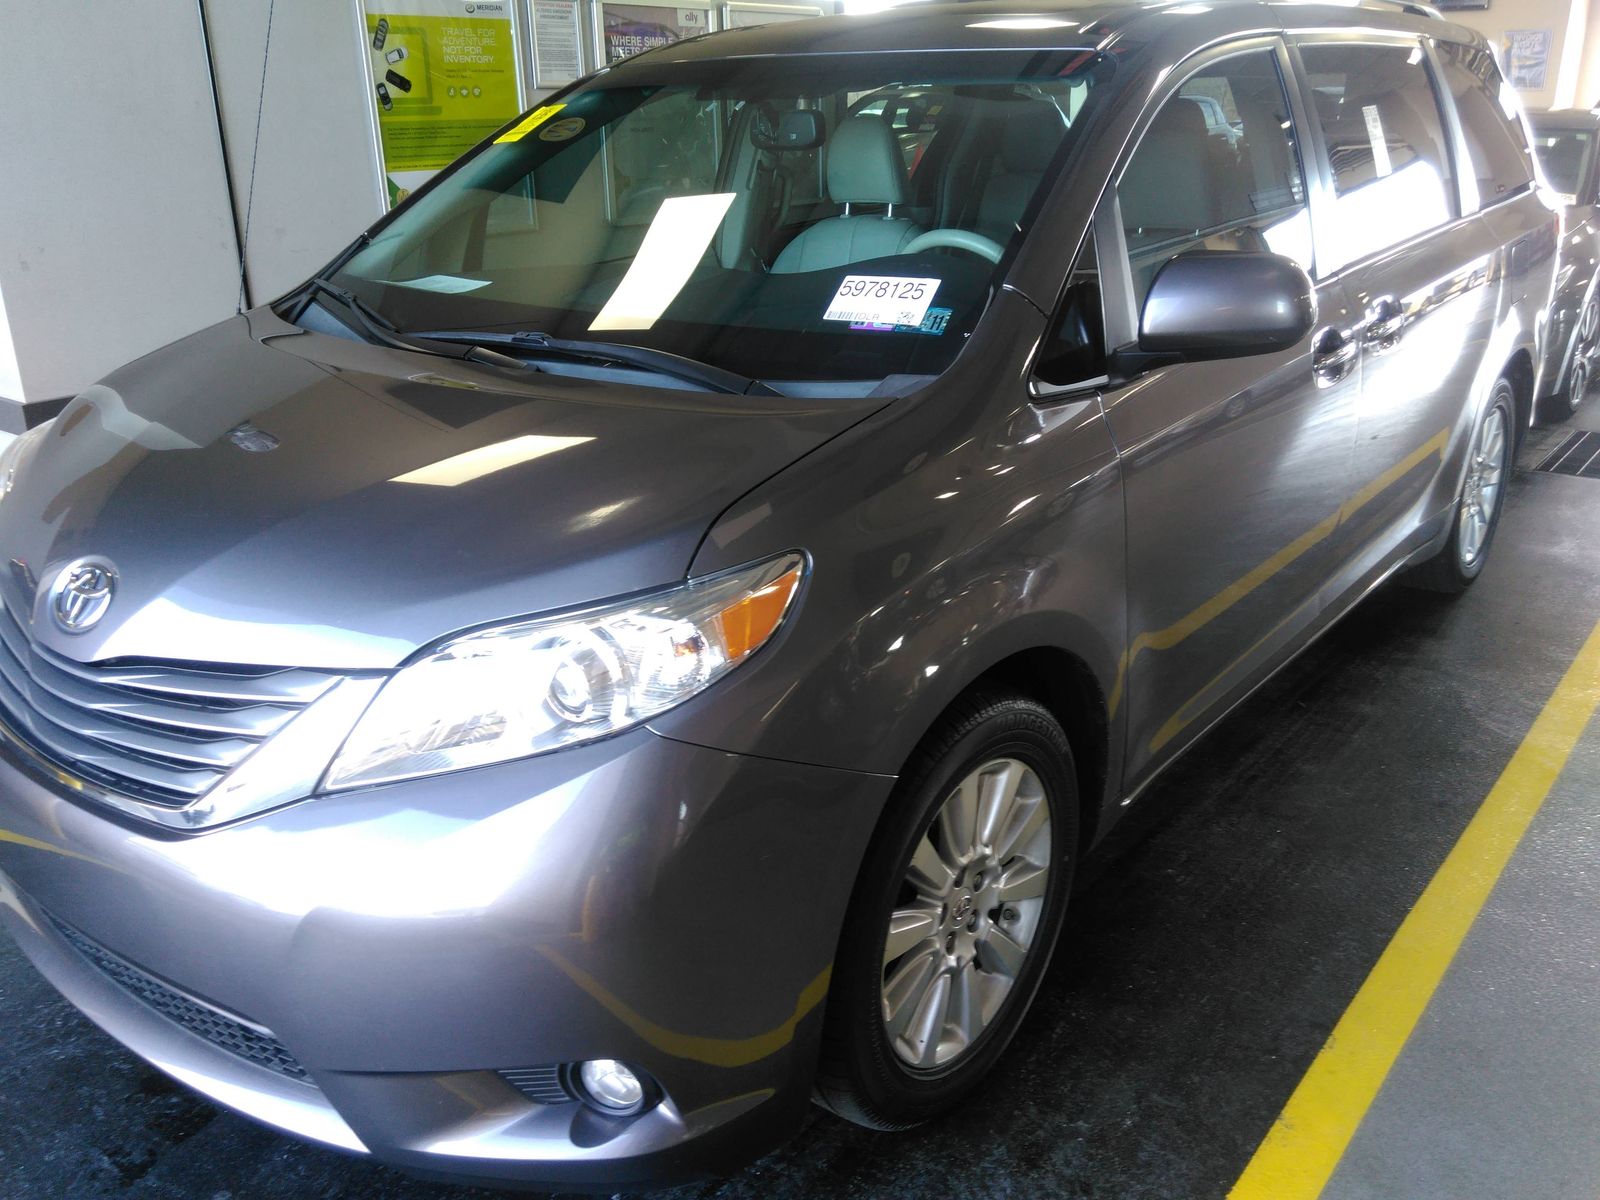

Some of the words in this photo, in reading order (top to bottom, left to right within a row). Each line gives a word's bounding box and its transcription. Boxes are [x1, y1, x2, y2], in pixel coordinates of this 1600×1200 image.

[476, 4, 503, 12] MERIDIAN
[685, 12, 698, 24] ally
[441, 27, 476, 37] TRAVEL
[477, 28, 496, 37] FOR
[442, 37, 497, 46] ADVENTURE
[610, 35, 642, 46] WHERE
[443, 46, 461, 55] NOT
[464, 46, 483, 55] FOR
[839, 280, 927, 300] 5978125
[929, 314, 945, 331] 11
